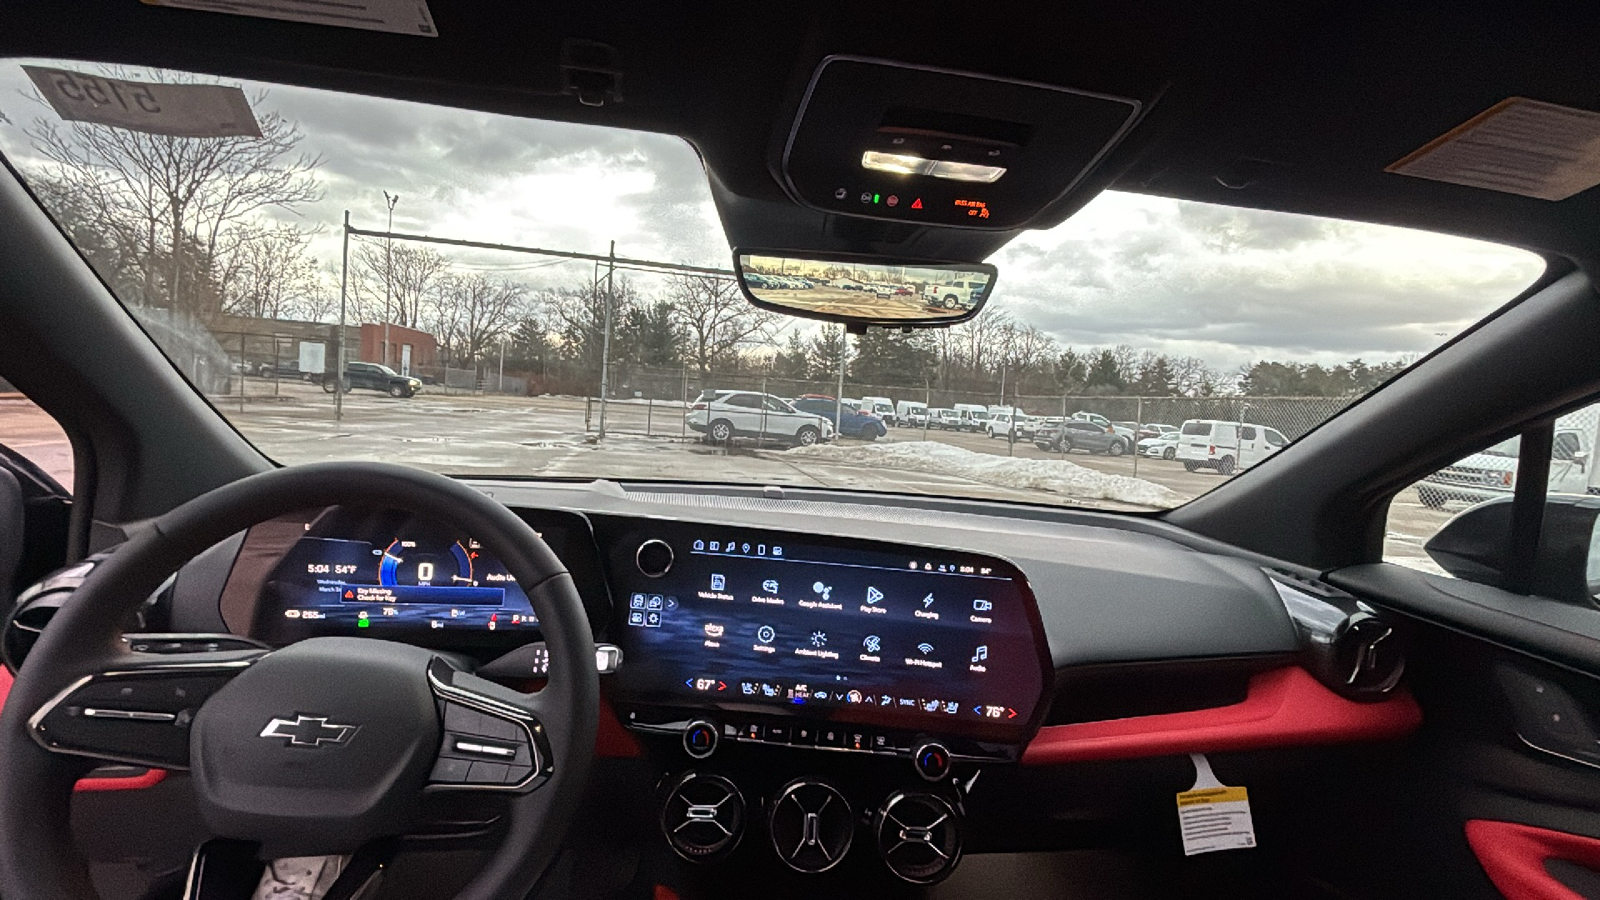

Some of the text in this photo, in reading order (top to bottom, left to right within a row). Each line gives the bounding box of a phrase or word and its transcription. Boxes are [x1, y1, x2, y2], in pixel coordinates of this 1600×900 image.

[307, 564, 330, 573] 5:04
[418, 562, 434, 581] 0
[486, 573, 506, 581] Audio
[697, 591, 734, 600] Vehicle Status
[798, 599, 842, 610] Google Assistant
[860, 604, 887, 614] Play Store
[914, 610, 939, 620] Charging
[970, 615, 992, 624] Camera
[753, 644, 775, 653] Settings
[795, 648, 839, 660] Ambient Lighting
[859, 654, 880, 663] Climate
[970, 664, 986, 673] Audio
